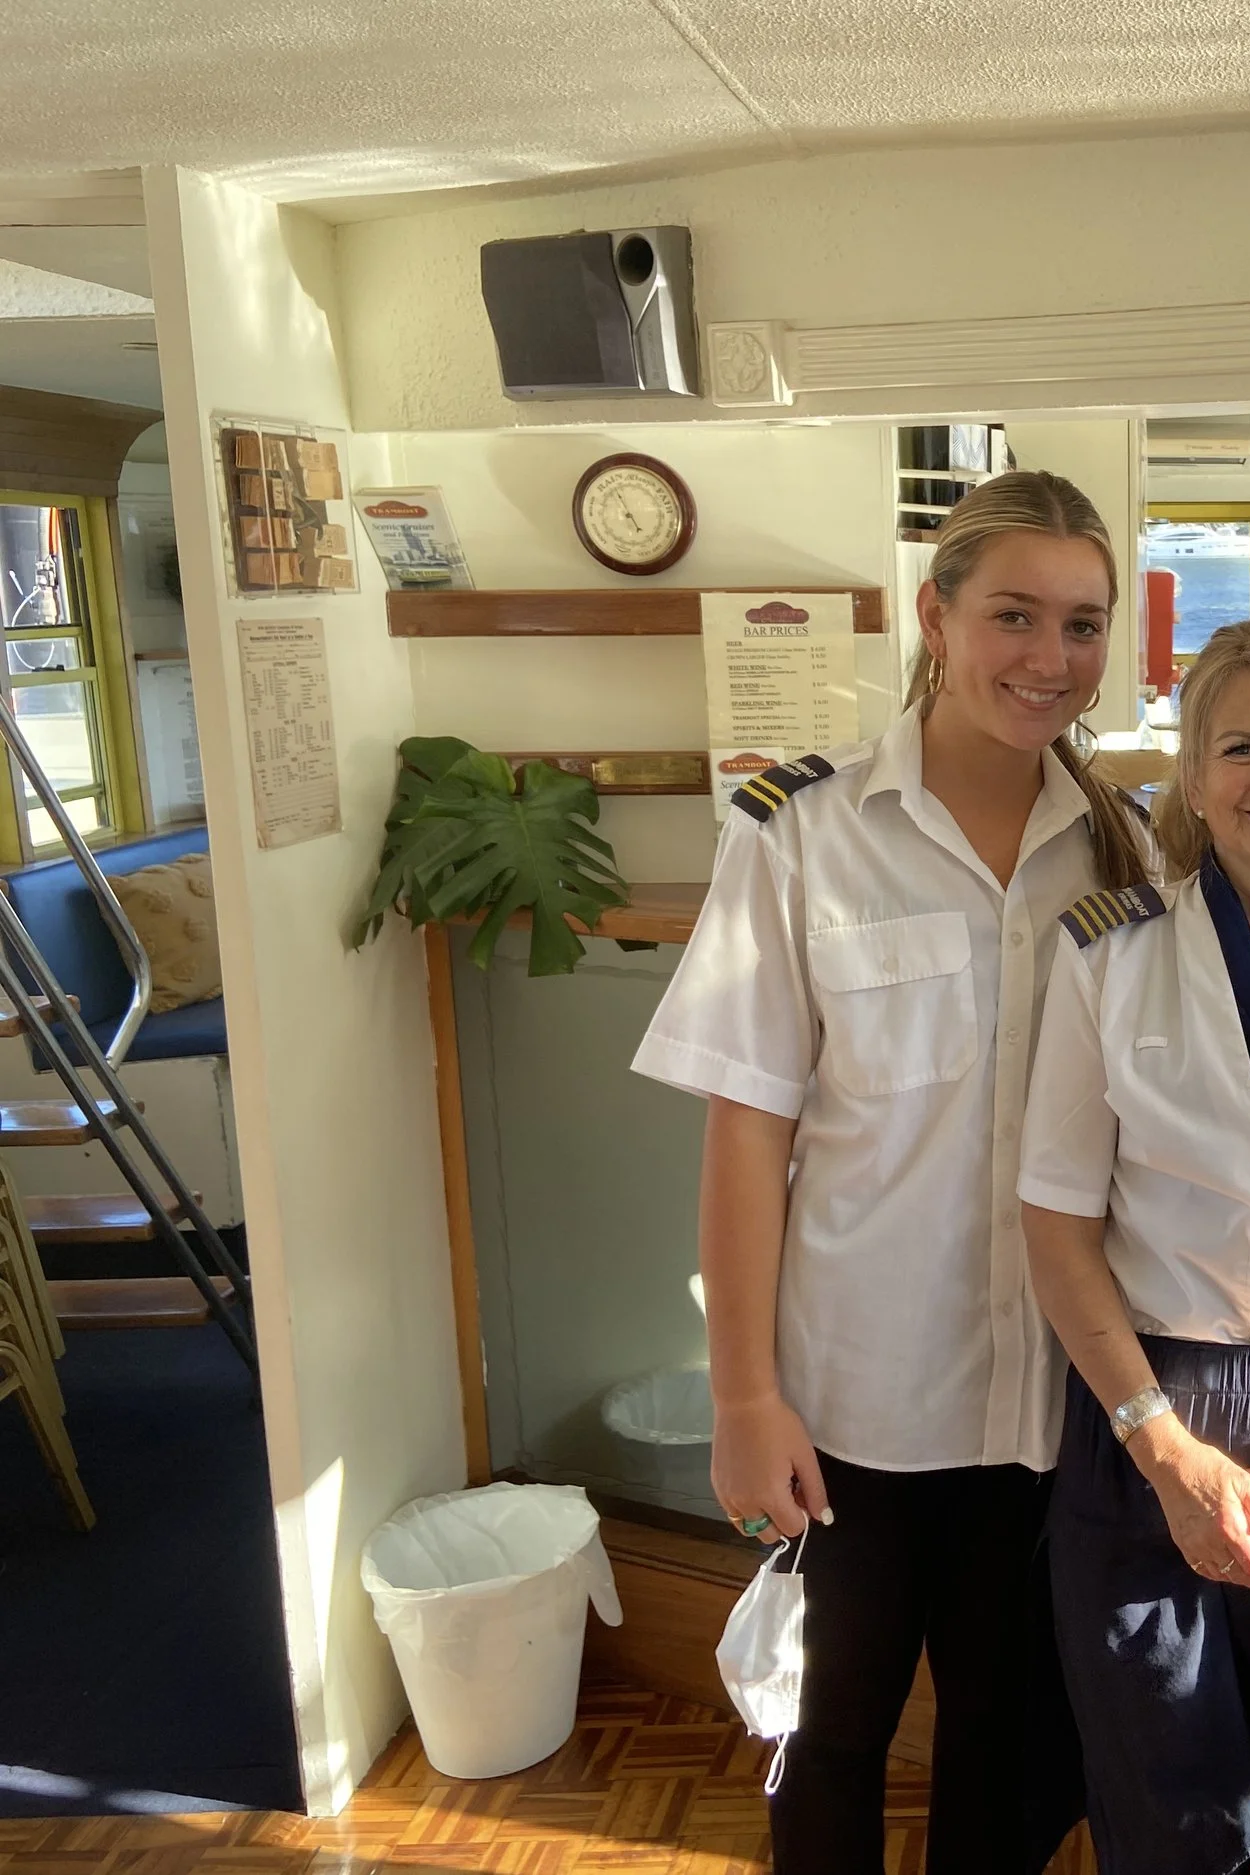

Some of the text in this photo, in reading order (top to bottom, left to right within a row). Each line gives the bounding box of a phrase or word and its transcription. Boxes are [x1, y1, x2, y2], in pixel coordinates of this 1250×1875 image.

[596, 473, 623, 492] RAIN
[656, 487, 674, 514] FAIR
[371, 507, 419, 515] TRAMBOAT
[744, 626, 809, 636] BAR PRICES
[726, 761, 772, 769] TRAMBOAT
